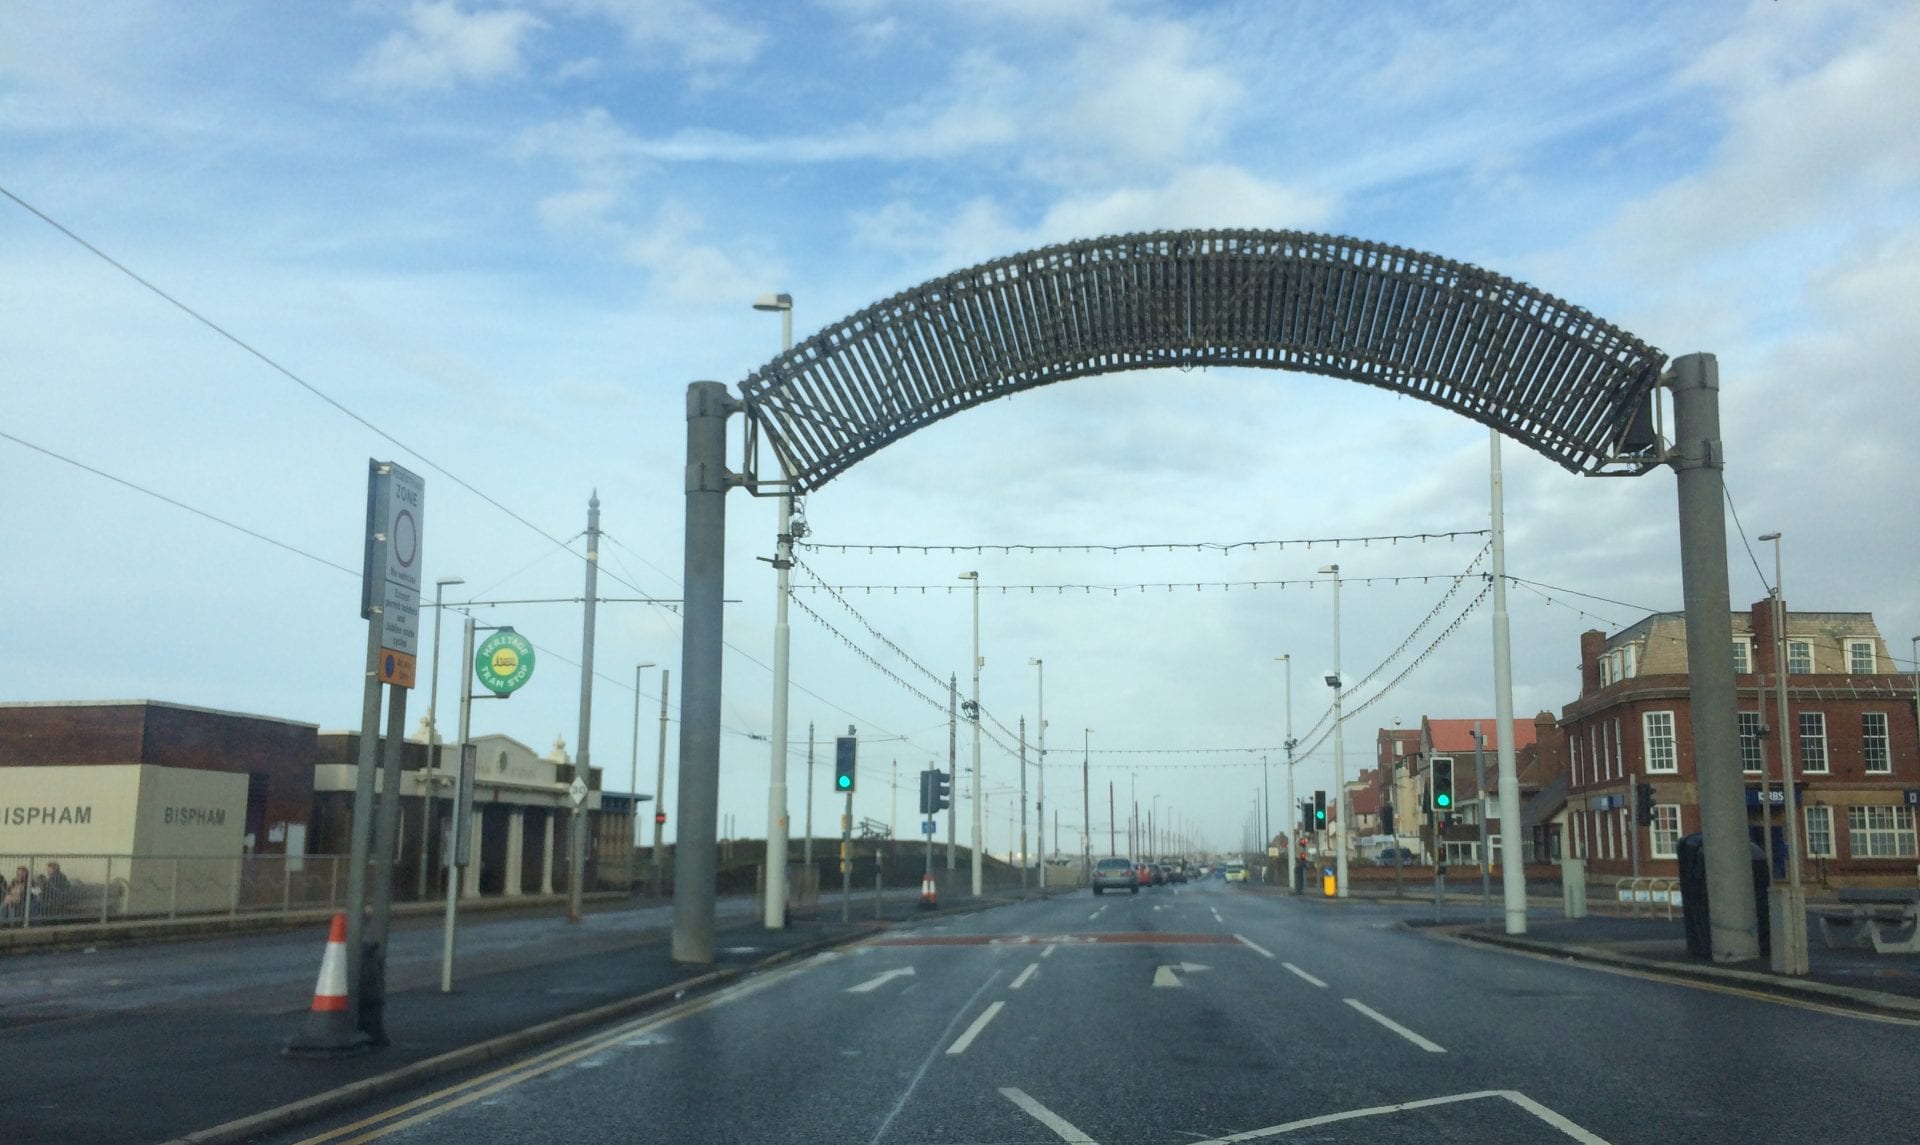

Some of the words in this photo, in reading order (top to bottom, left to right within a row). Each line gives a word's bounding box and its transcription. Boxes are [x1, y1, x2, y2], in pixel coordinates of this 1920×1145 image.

[396, 484, 417, 507] ZONE
[483, 636, 528, 657] HERITAGE
[482, 666, 504, 688] TRAM
[508, 665, 527, 687] STOP
[0, 806, 92, 826] ISPHAM
[164, 806, 226, 826] BISPHAM
